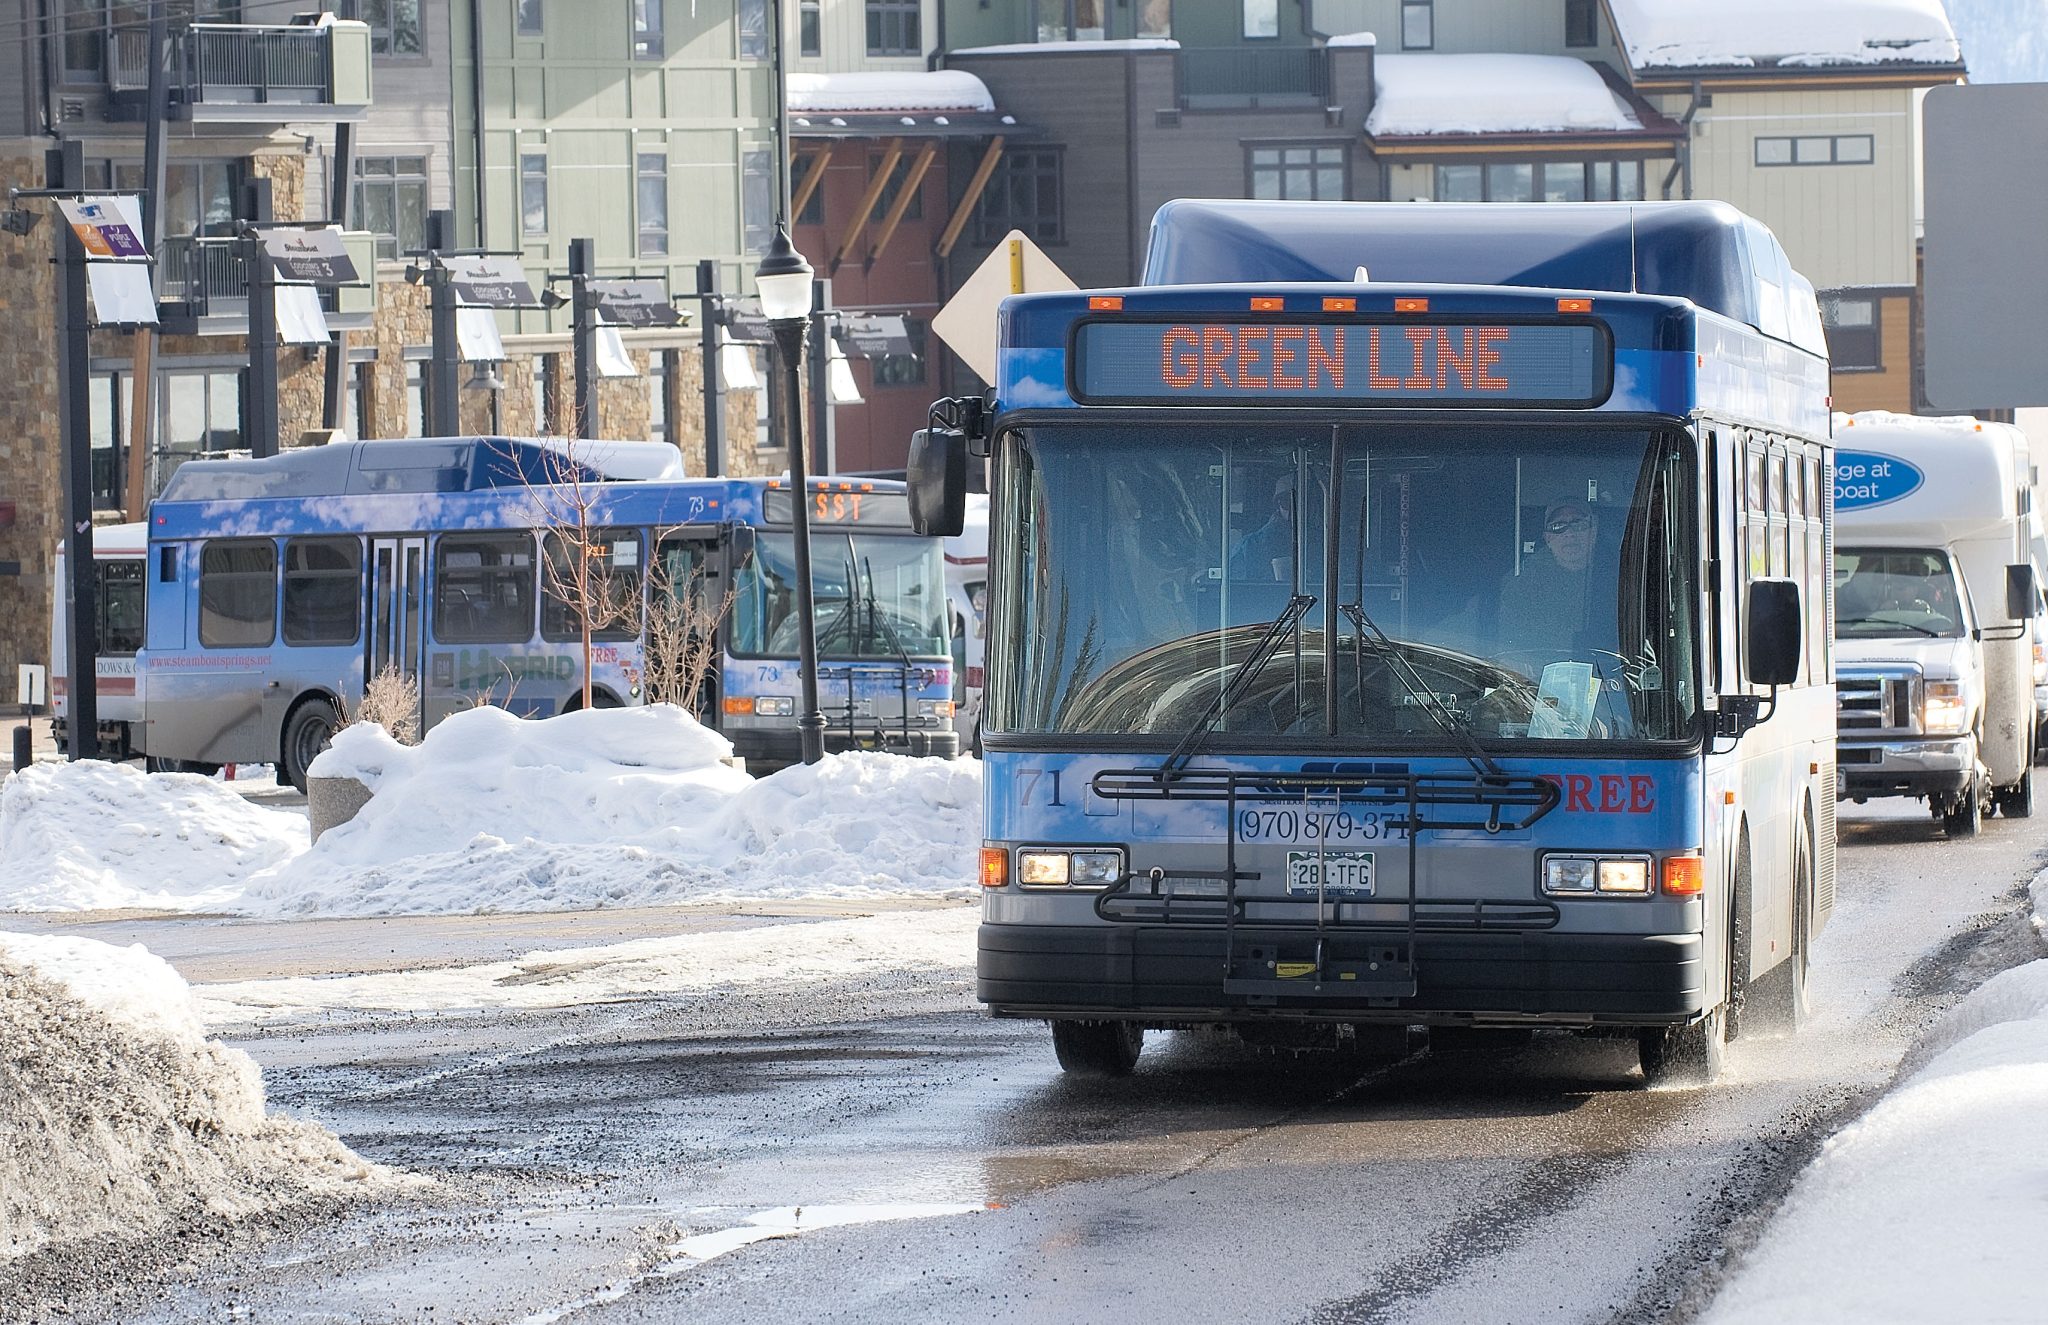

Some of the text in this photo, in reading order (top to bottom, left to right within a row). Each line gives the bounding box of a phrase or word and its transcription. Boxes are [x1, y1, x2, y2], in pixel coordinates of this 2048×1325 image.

[322, 262, 334, 277] 3
[504, 286, 517, 299] 2
[646, 308, 657, 319] 1
[1162, 326, 1509, 390] GREEN LINE
[1871, 461, 1891, 477] at
[688, 496, 704, 513] 73
[816, 493, 862, 521] SST
[149, 654, 272, 669] www.steamboatsprings.net
[590, 647, 618, 663] FREE
[124, 662, 131, 673] &
[436, 660, 450, 673] GM
[459, 649, 576, 689] HYBRID
[757, 666, 778, 682] 73
[1016, 768, 1066, 807] 71
[1238, 810, 1299, 843] (970)
